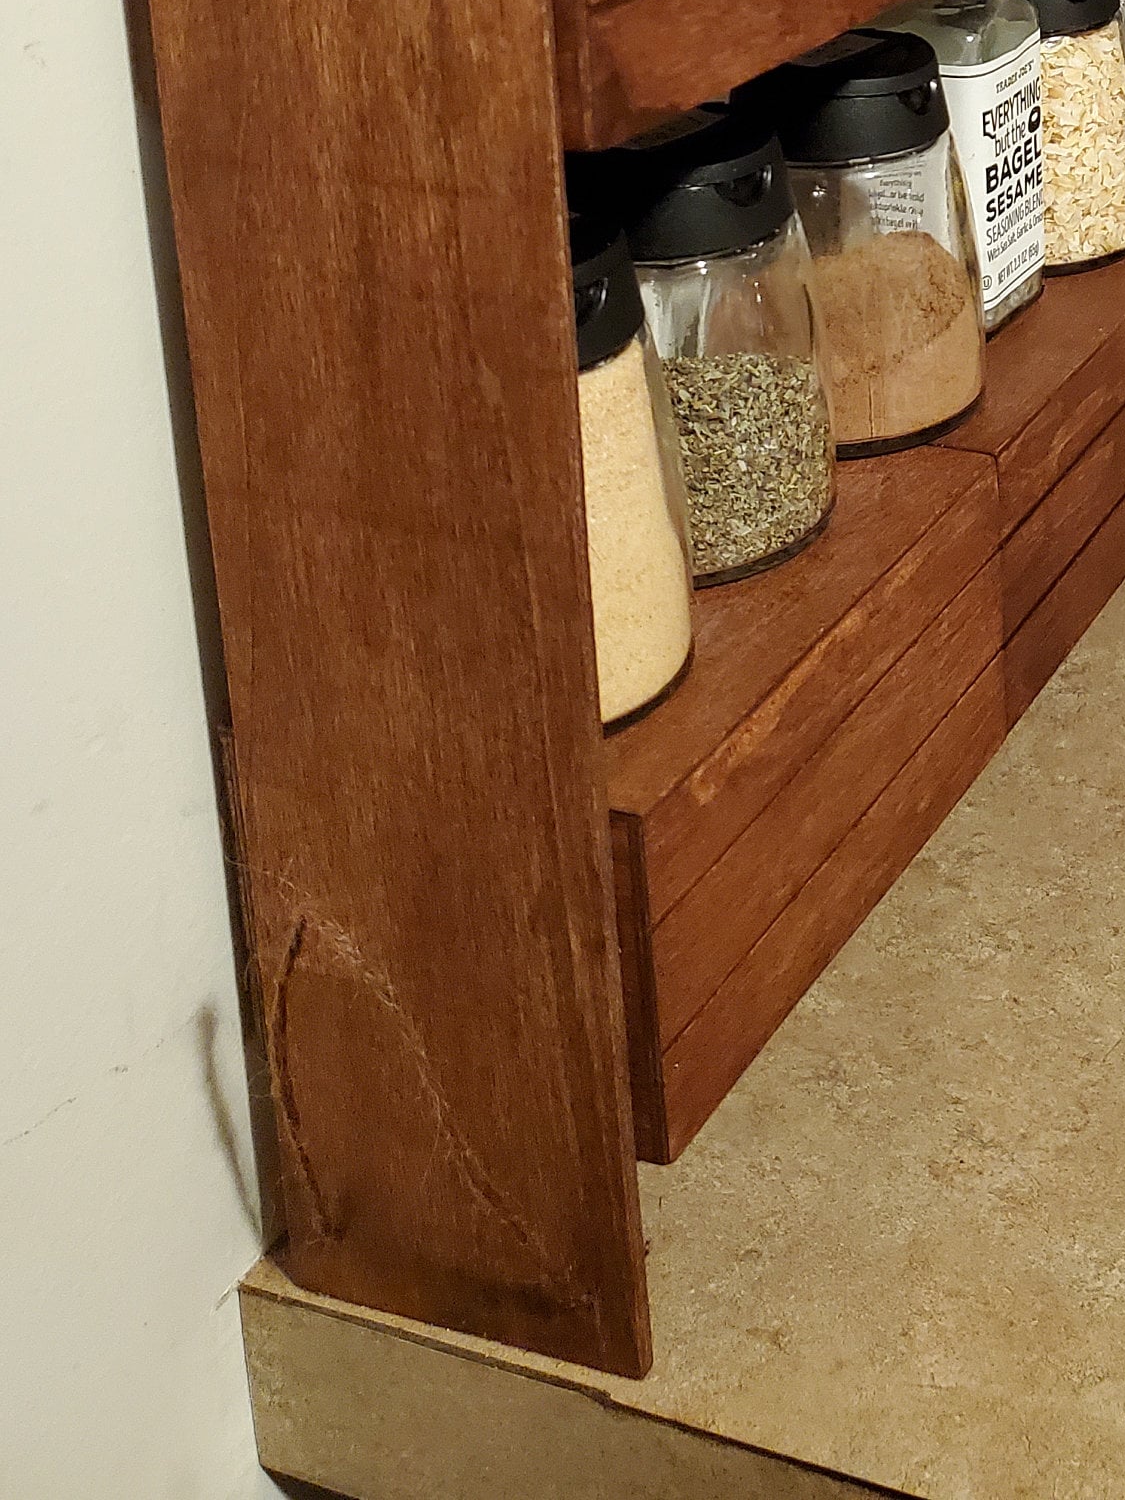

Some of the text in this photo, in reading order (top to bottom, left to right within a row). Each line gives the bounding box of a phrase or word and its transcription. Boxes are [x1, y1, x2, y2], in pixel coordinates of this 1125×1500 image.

[982, 76, 1041, 140] EVERYTHING
[995, 118, 1026, 158] but the
[985, 133, 1042, 195] BAGEL
[986, 161, 1043, 223] SESAME
[986, 203, 1025, 246] SEASONING
